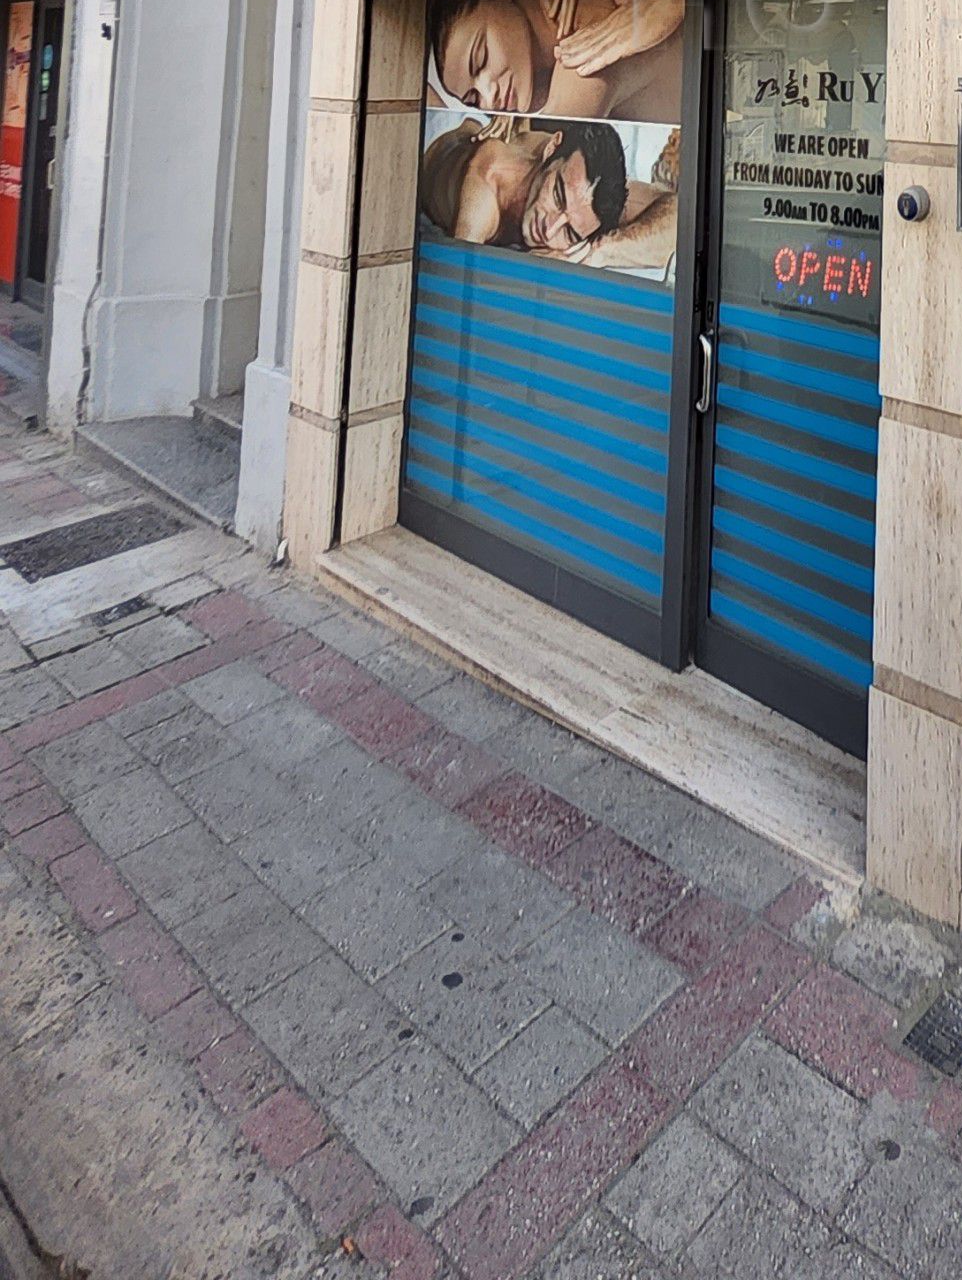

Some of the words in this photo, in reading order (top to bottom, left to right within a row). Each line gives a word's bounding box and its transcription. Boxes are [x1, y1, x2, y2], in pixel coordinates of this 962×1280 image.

[774, 133, 796, 153] WE
[797, 135, 825, 155] ARE
[828, 137, 870, 159] OPEN
[733, 162, 770, 184] FROM
[772, 166, 832, 191] MONDAY
[833, 170, 854, 193] TO
[763, 197, 808, 220] 9.00AM
[809, 202, 828, 223] TO
[830, 206, 880, 231] 8.00PM
[774, 247, 873, 298] OPEN
